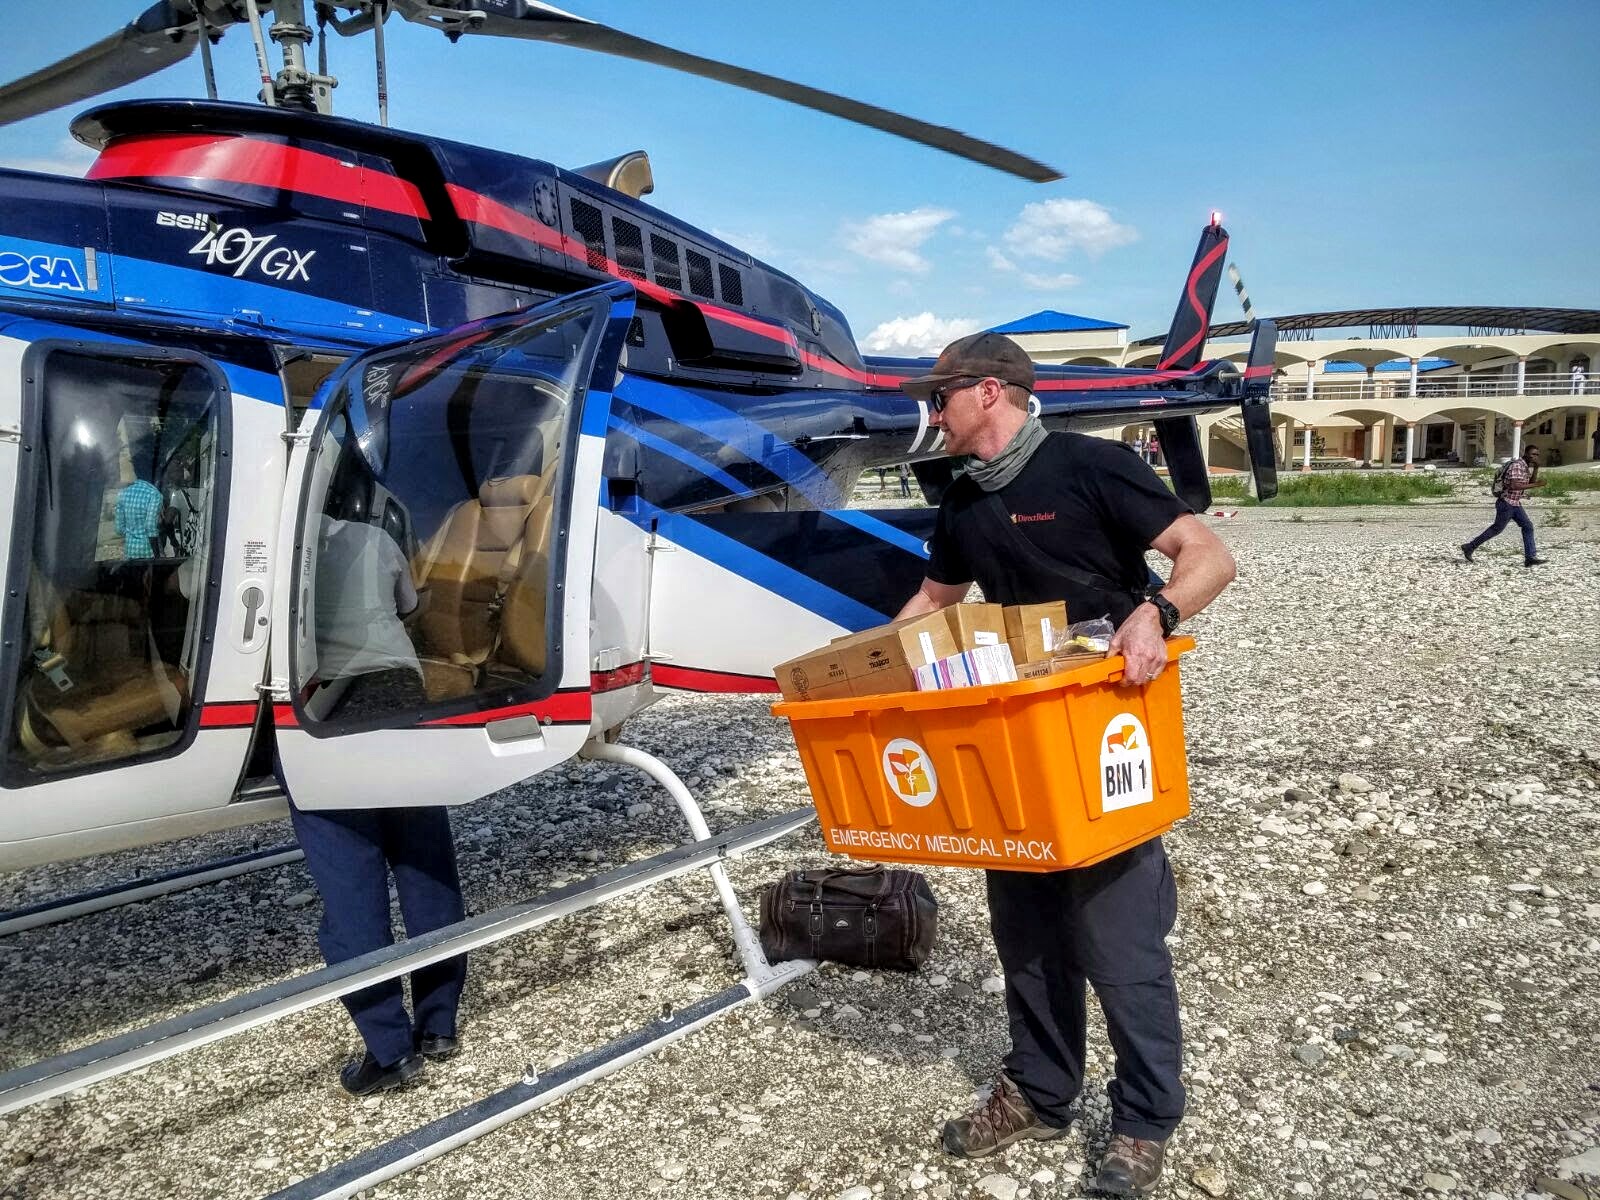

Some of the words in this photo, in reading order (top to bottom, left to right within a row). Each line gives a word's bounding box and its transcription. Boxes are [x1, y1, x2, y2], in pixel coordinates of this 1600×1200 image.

[156, 211, 209, 231] Bell
[188, 223, 277, 277] 407
[1105, 762, 1132, 797] BIN
[1138, 759, 1146, 789] 1
[830, 828, 921, 850] EMERGENCY
[925, 835, 1002, 857] MEDICAL
[1003, 839, 1057, 861] PACK
